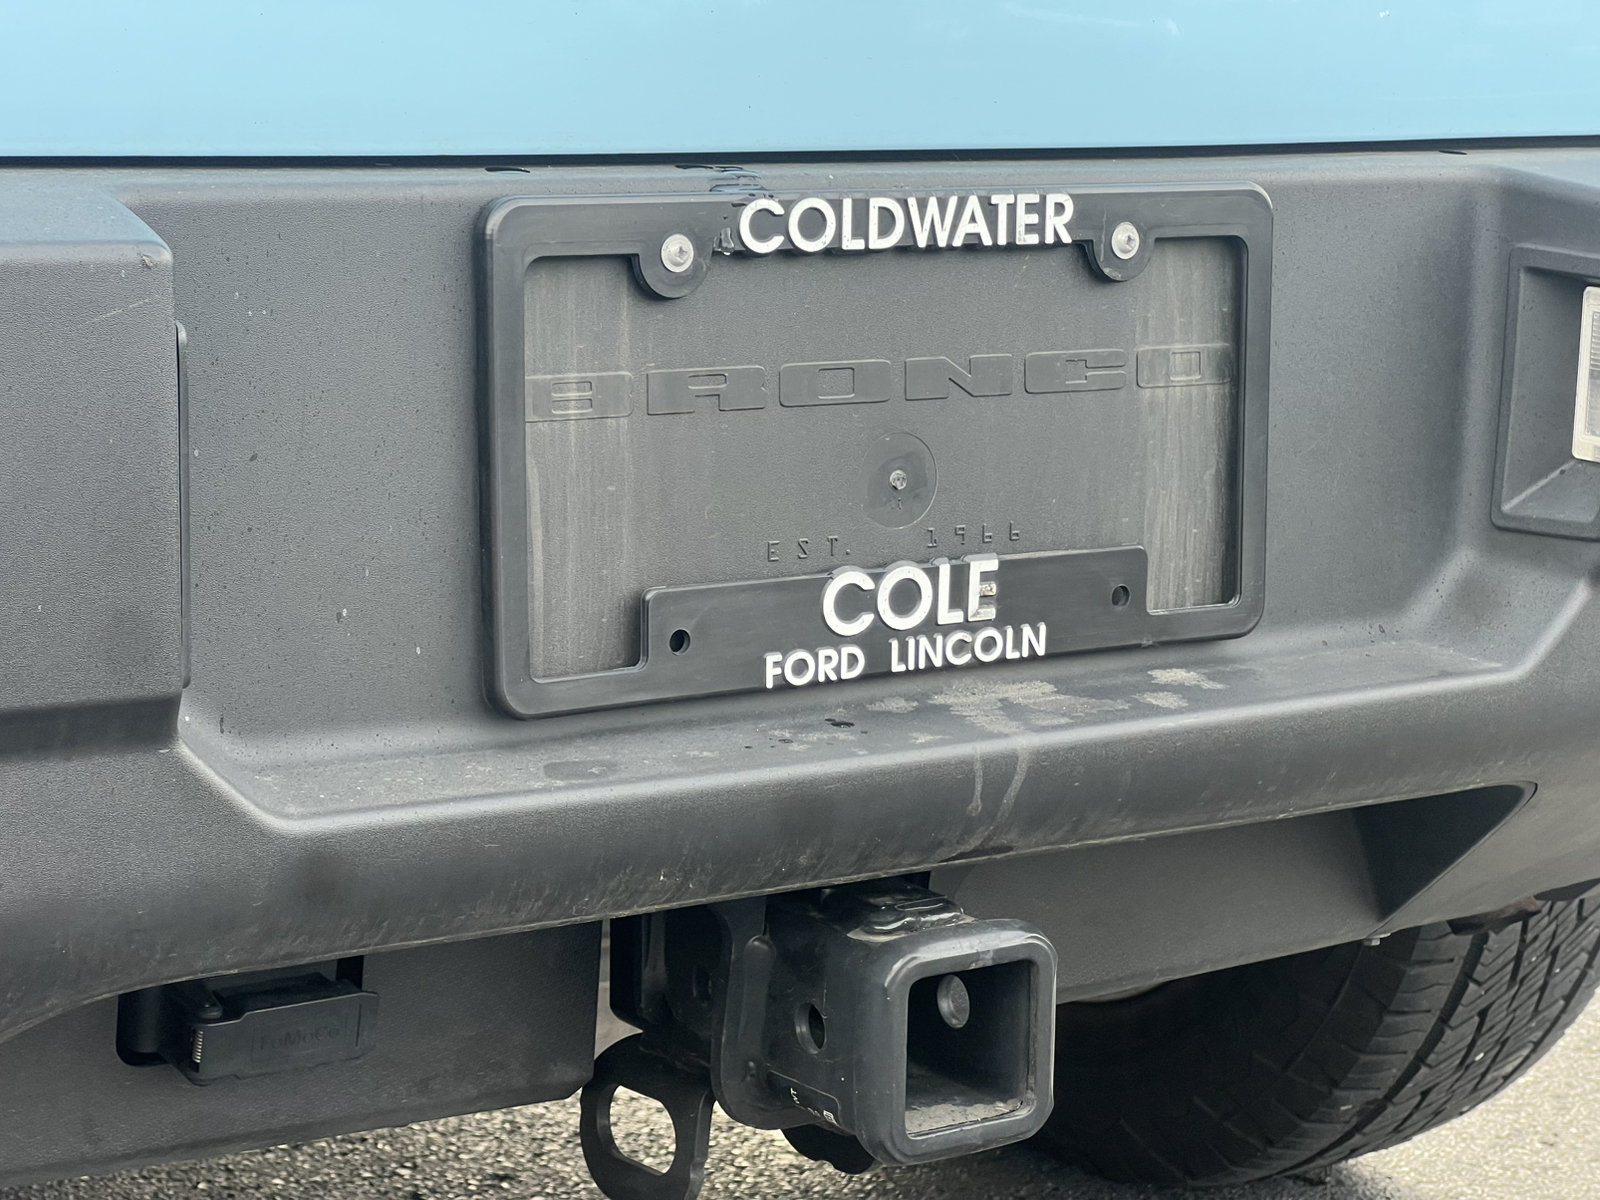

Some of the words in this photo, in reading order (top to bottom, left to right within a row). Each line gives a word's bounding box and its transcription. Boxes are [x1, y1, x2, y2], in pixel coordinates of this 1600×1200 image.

[738, 192, 1075, 254] COLDWATER
[524, 343, 1232, 423] BRONCO
[767, 535, 850, 562] EST.
[926, 520, 1021, 549] 1966
[821, 553, 999, 637] COLE
[764, 644, 866, 690] FORD
[889, 622, 1047, 673] LINCOLN
